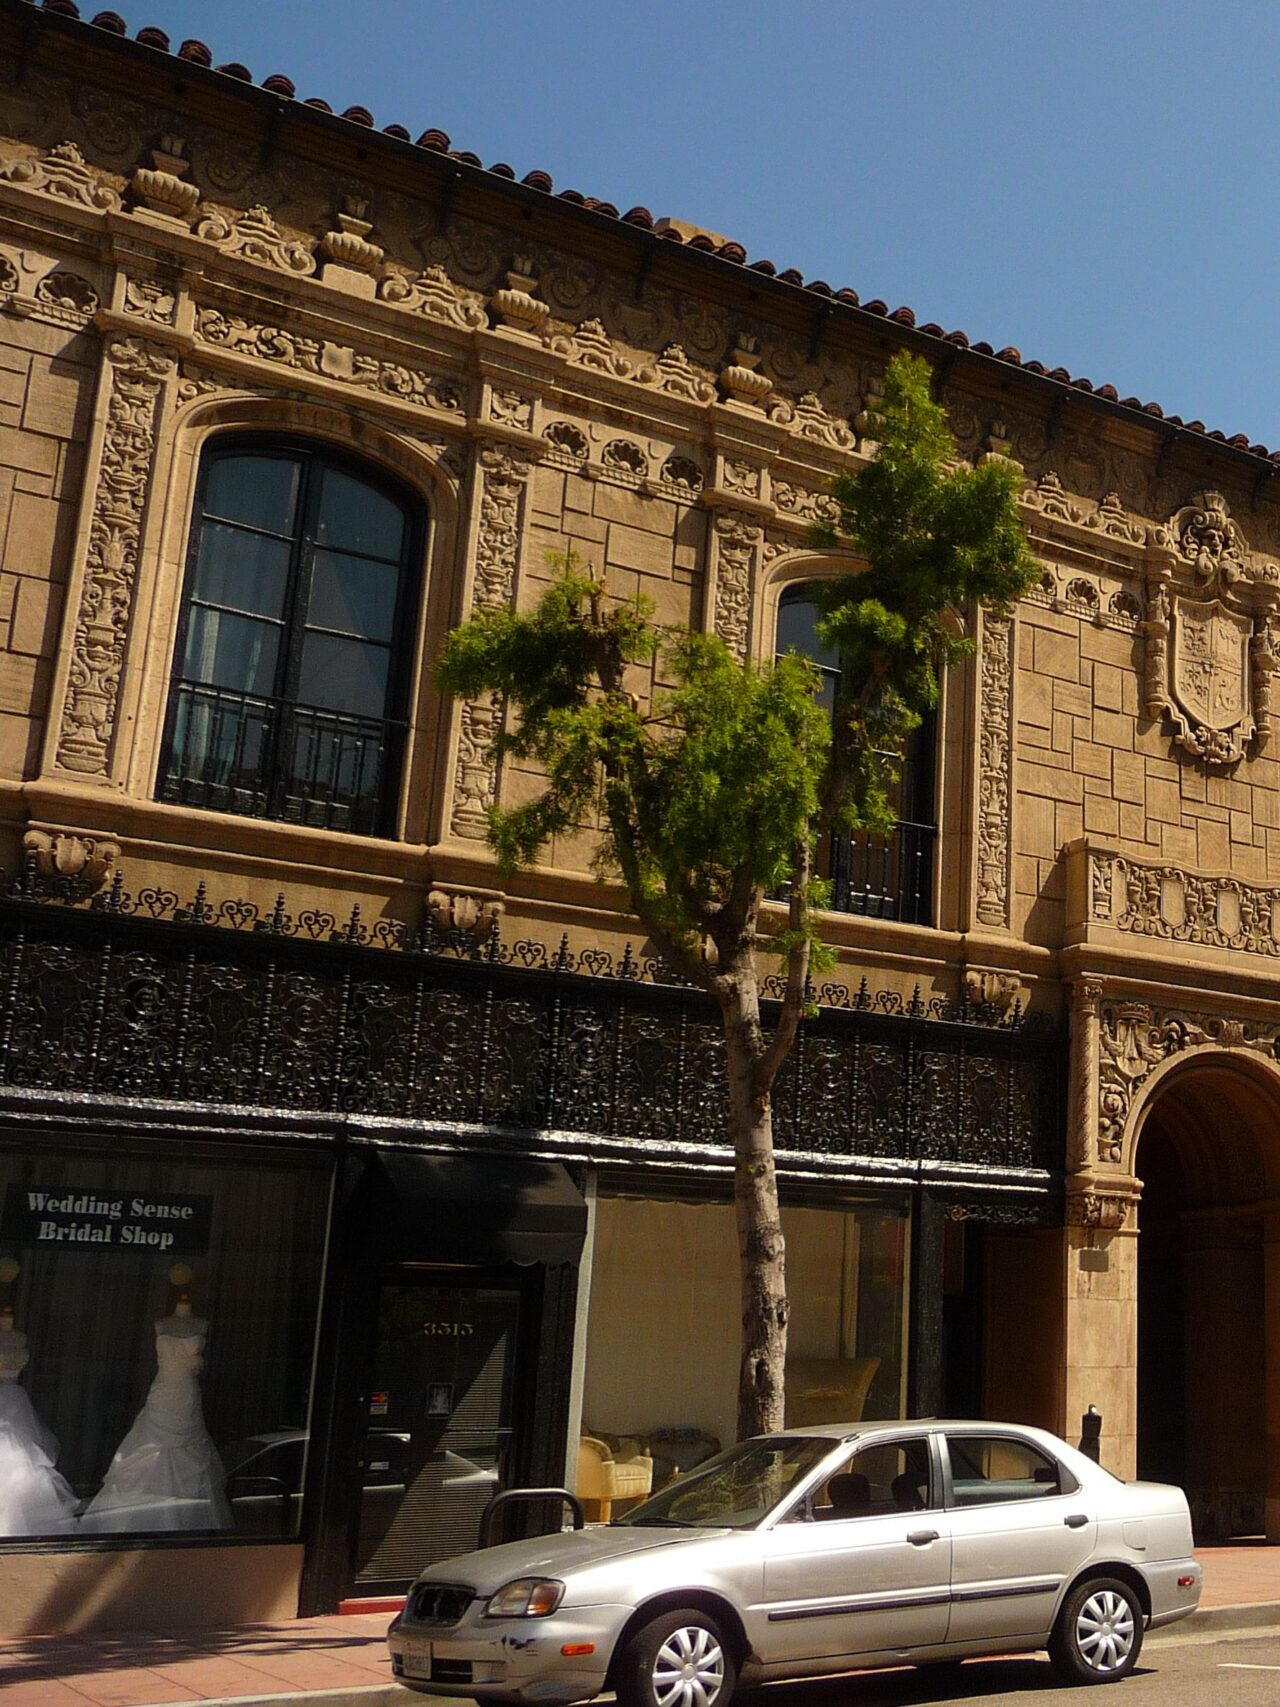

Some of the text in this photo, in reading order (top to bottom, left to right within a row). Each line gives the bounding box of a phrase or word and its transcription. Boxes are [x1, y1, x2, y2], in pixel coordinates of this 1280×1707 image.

[27, 1192, 194, 1220] Wedding Sense
[37, 1221, 175, 1250] Bridal Shop
[423, 1322, 474, 1336] 3515
